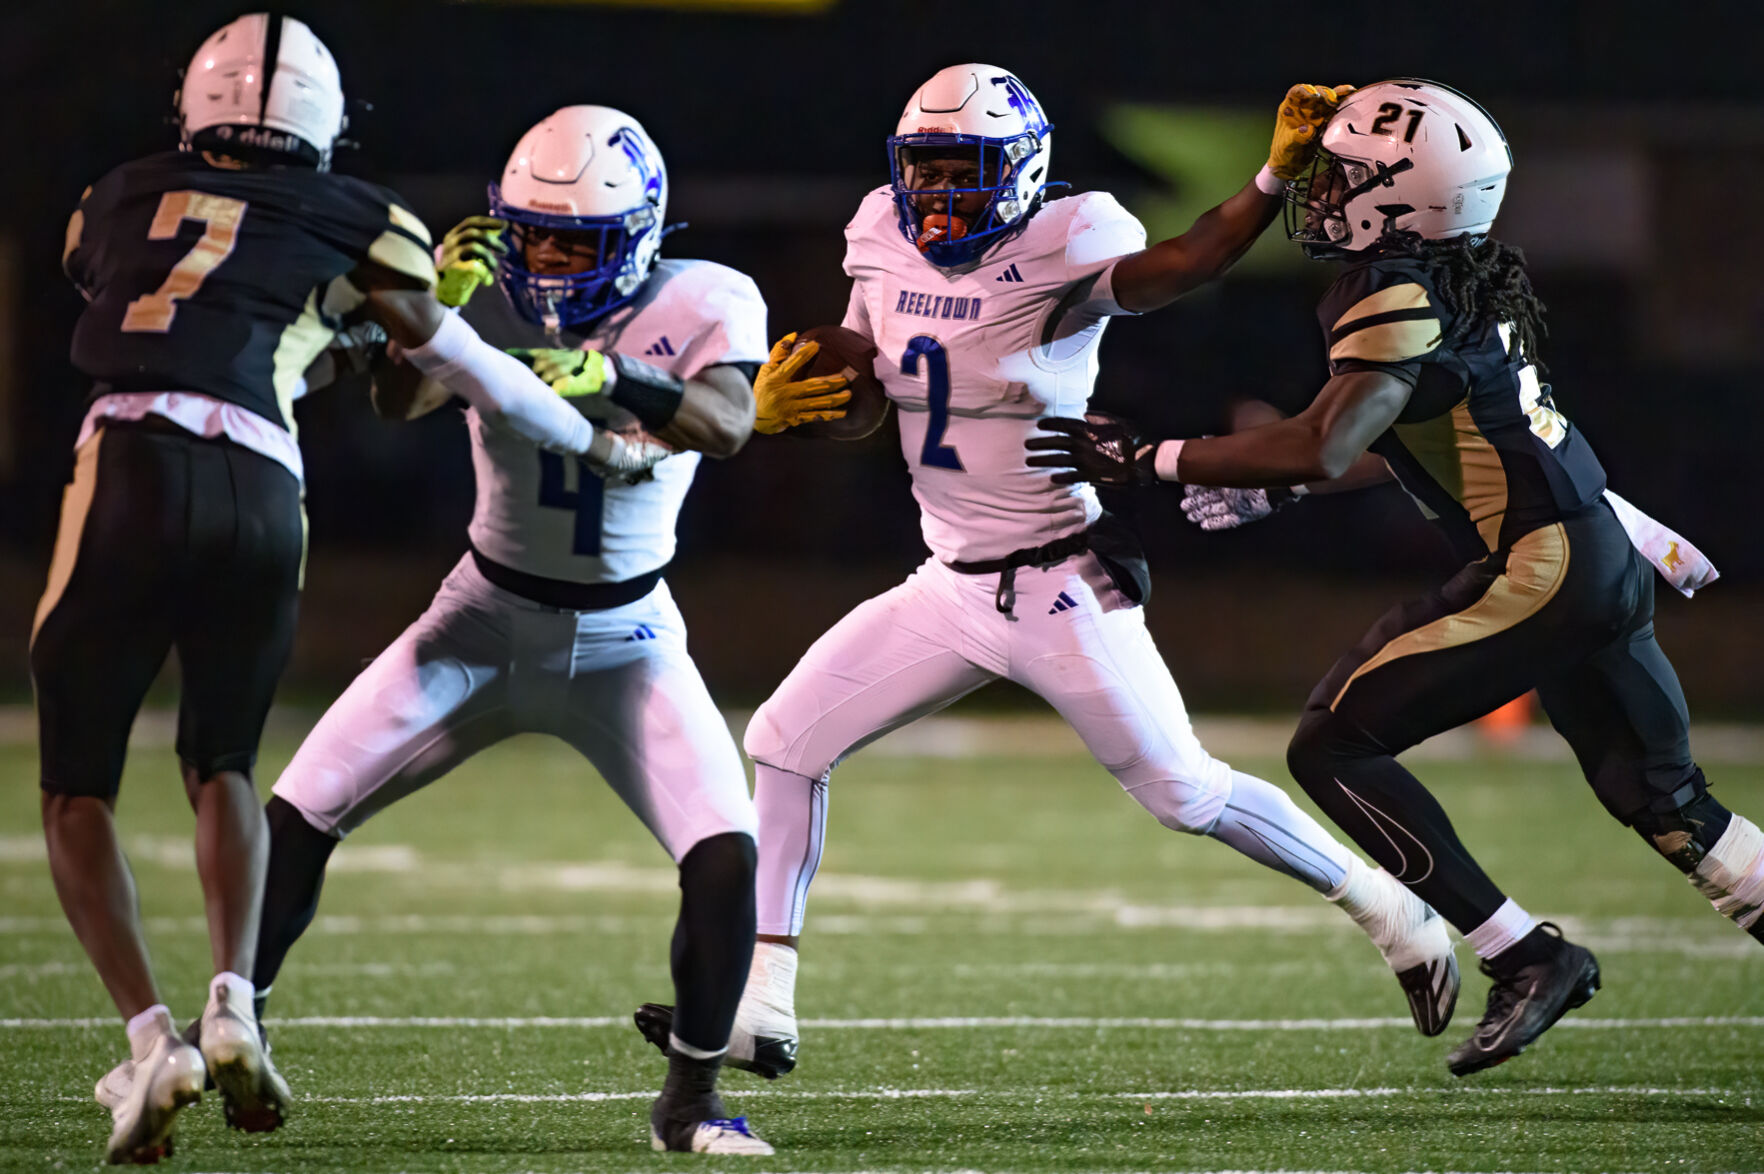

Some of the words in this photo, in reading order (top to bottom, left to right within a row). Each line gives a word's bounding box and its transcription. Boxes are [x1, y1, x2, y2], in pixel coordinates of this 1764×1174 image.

[1370, 101, 1426, 144] 21
[120, 189, 249, 333] 7
[895, 289, 982, 321] REELTOWN
[900, 332, 967, 473] 2
[537, 417, 606, 558] 4
